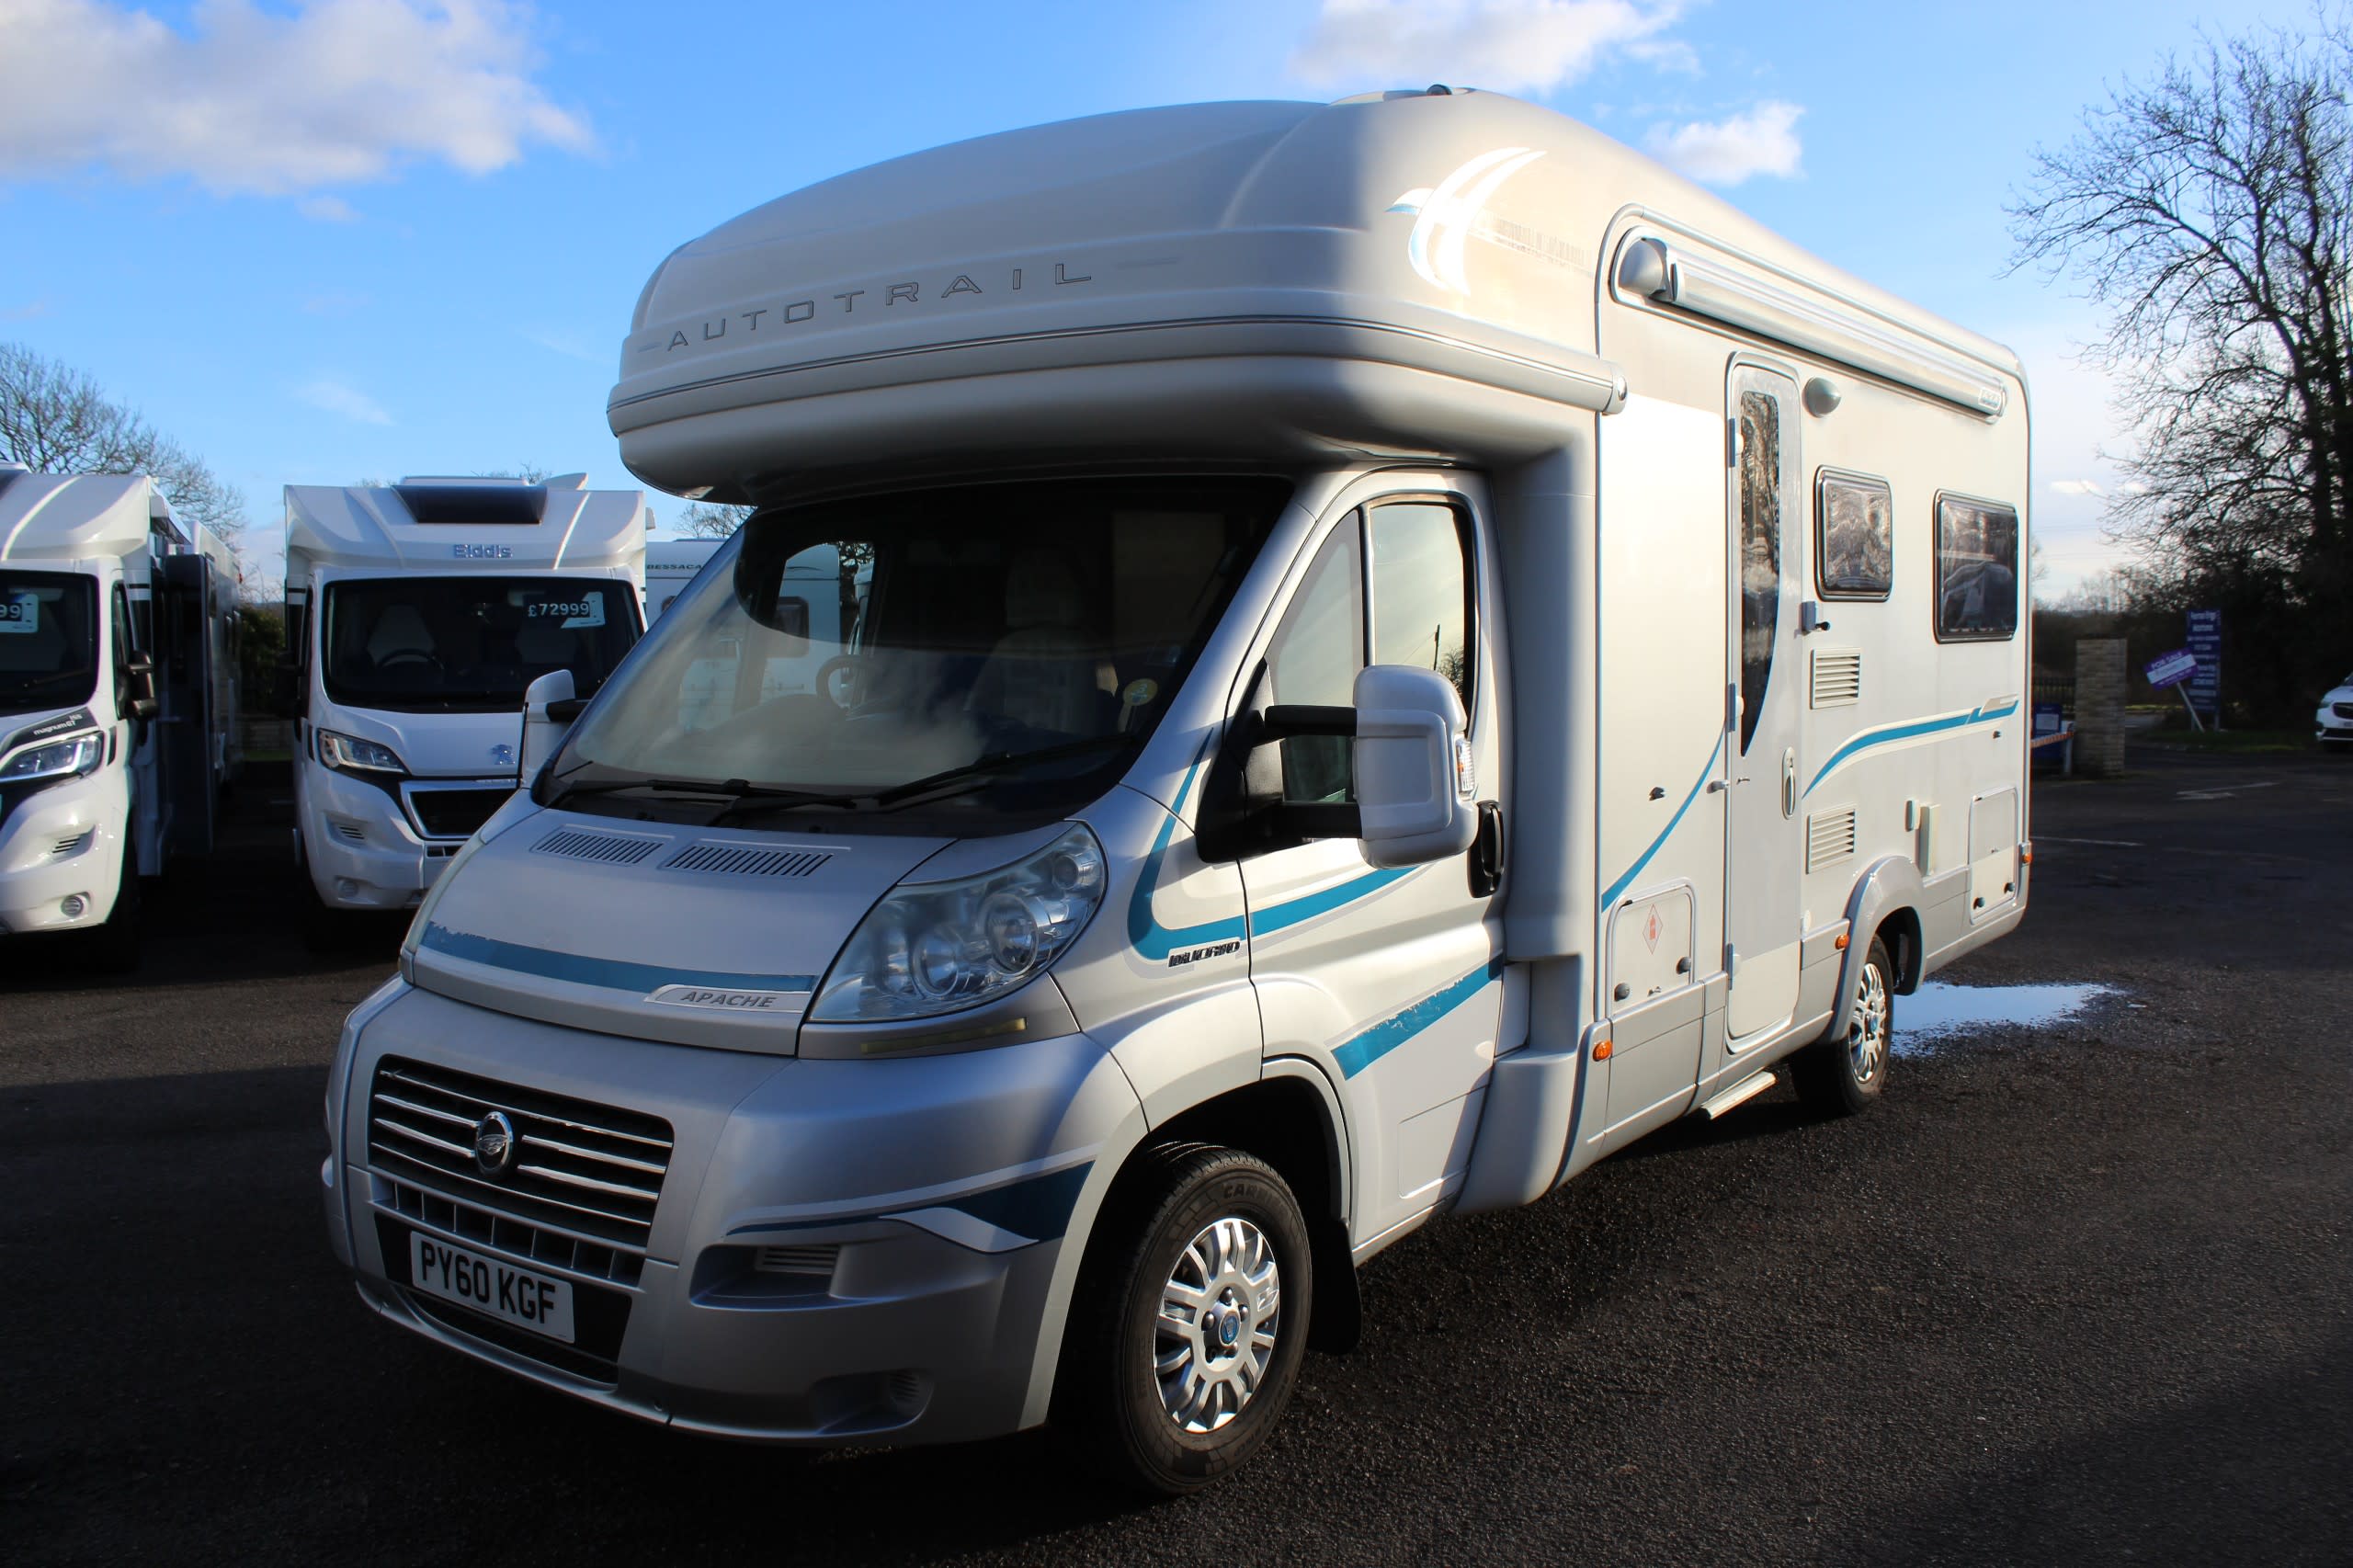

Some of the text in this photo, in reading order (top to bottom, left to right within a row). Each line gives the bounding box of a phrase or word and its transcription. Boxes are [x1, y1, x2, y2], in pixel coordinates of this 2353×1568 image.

[667, 263, 1091, 351] AUTOTRAIL
[453, 543, 514, 559] Elddis
[528, 603, 589, 617] £72999
[680, 991, 778, 1008] APACHE
[420, 1240, 556, 1324] PY60 KGF
